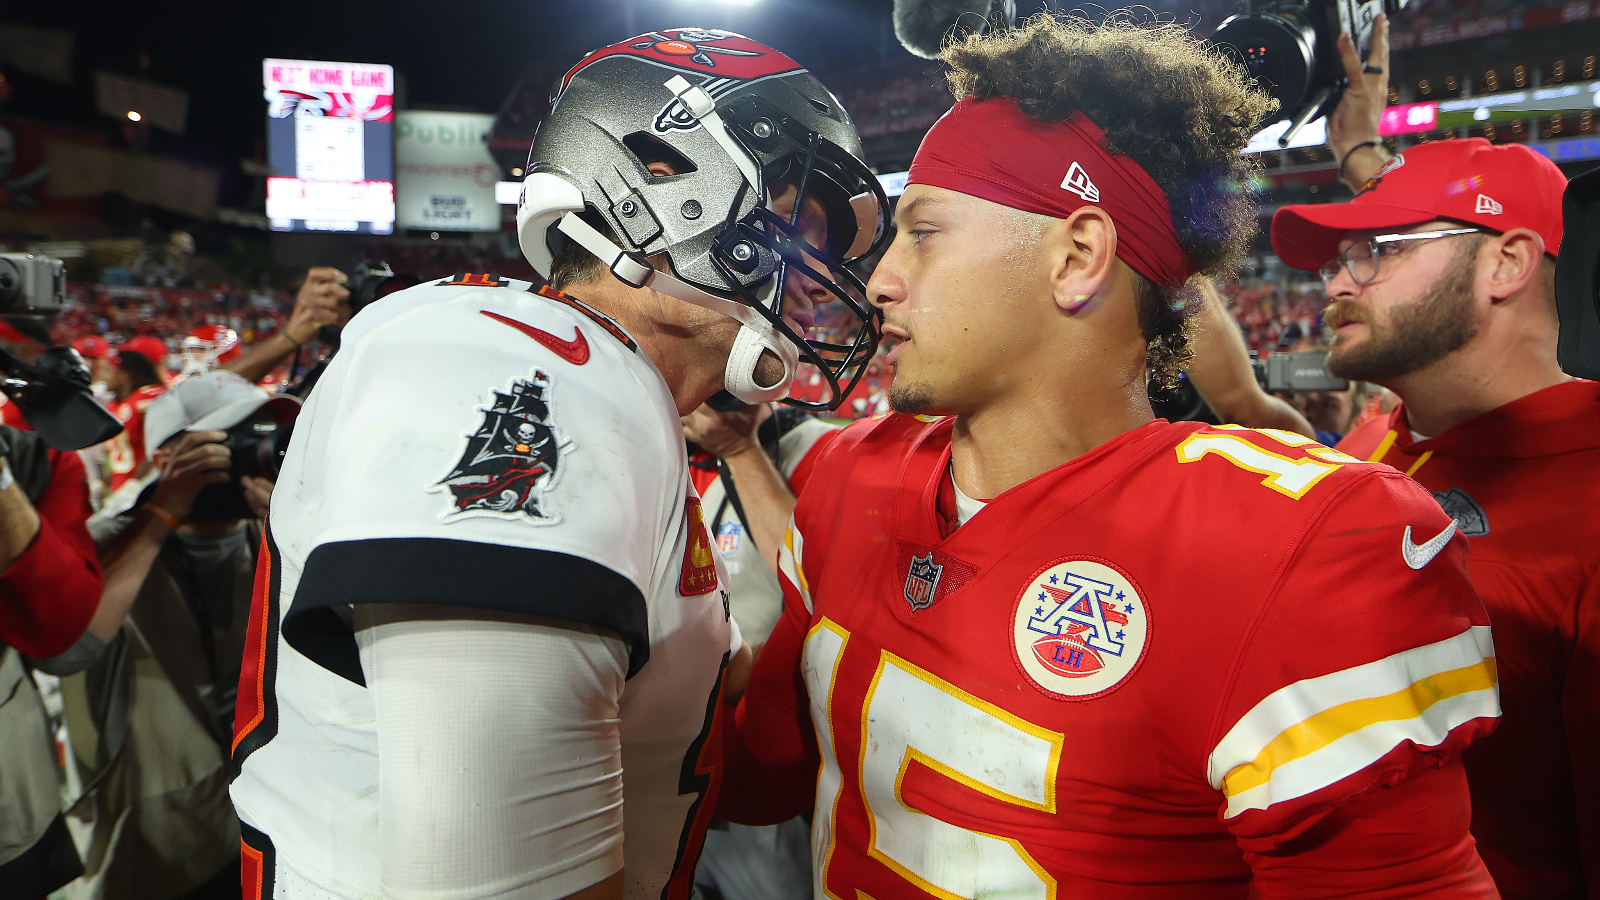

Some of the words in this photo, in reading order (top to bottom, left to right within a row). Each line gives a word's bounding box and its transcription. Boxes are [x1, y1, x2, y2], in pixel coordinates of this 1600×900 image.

[396, 120, 484, 146] Publi
[907, 576, 929, 602] NFL
[1052, 645, 1084, 668] LH
[801, 614, 1064, 900] 15
